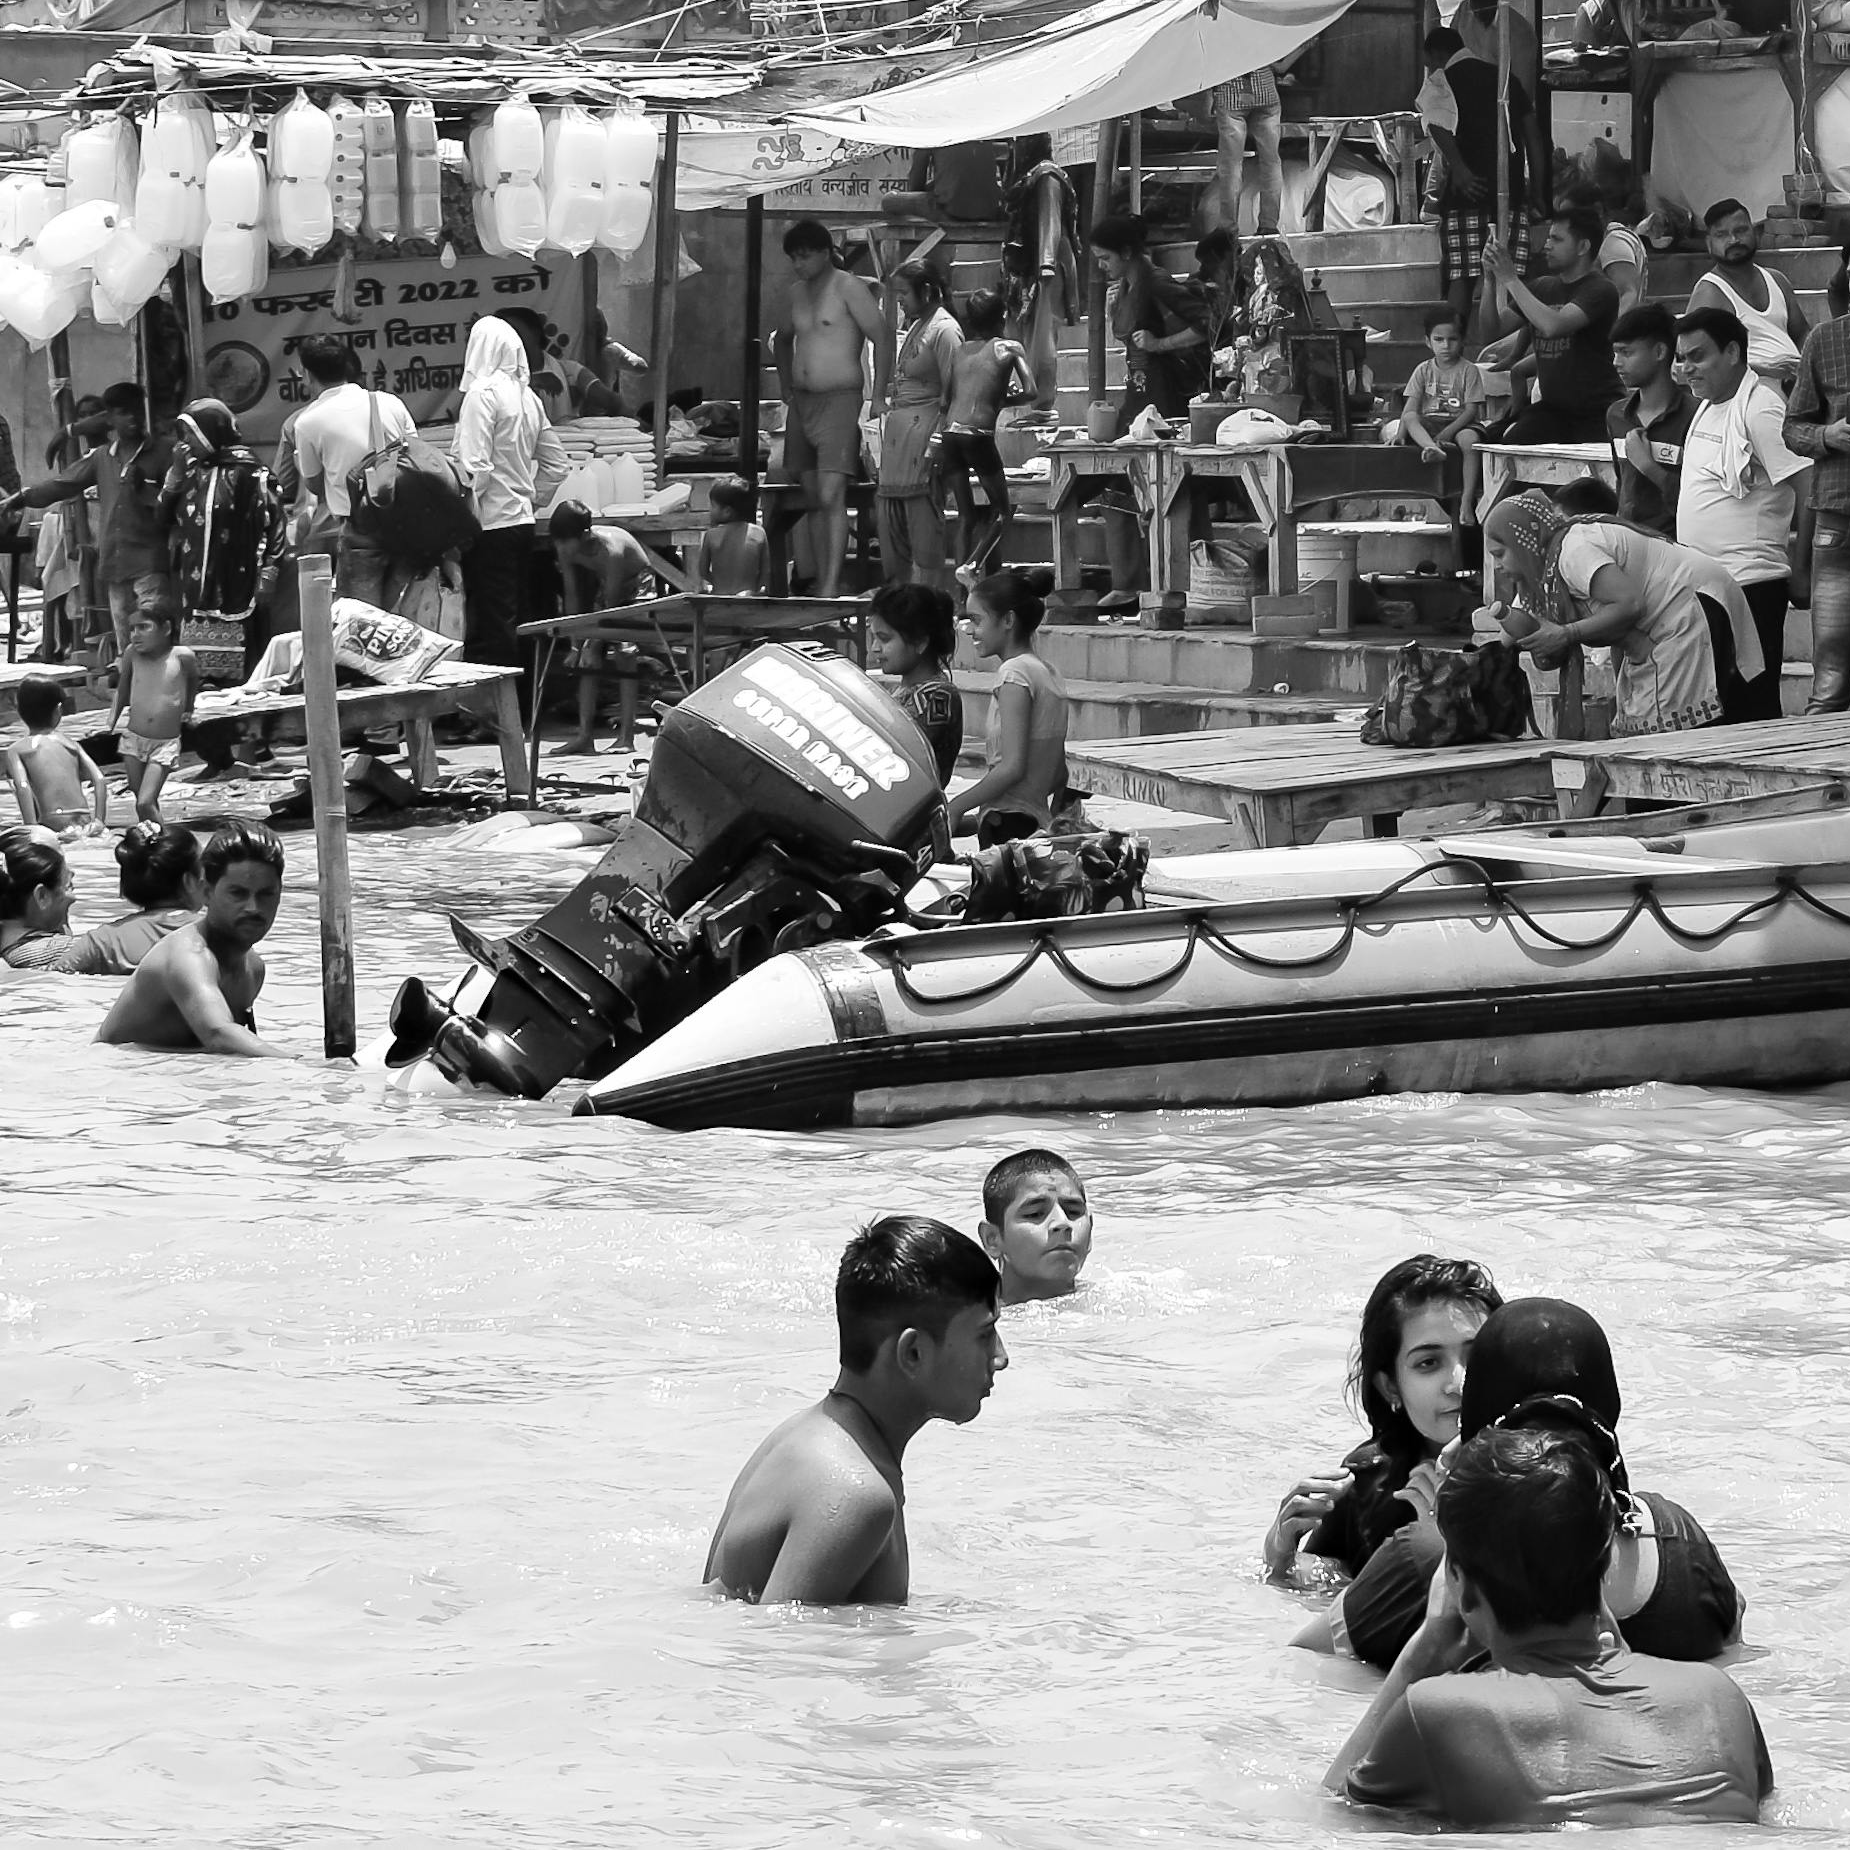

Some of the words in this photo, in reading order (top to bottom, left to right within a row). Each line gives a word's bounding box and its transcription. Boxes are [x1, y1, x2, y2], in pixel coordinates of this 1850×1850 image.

[821, 172, 870, 198] वन्यजीव
[398, 278, 480, 304] 2022
[492, 265, 552, 294] को
[384, 318, 457, 348] दिवस
